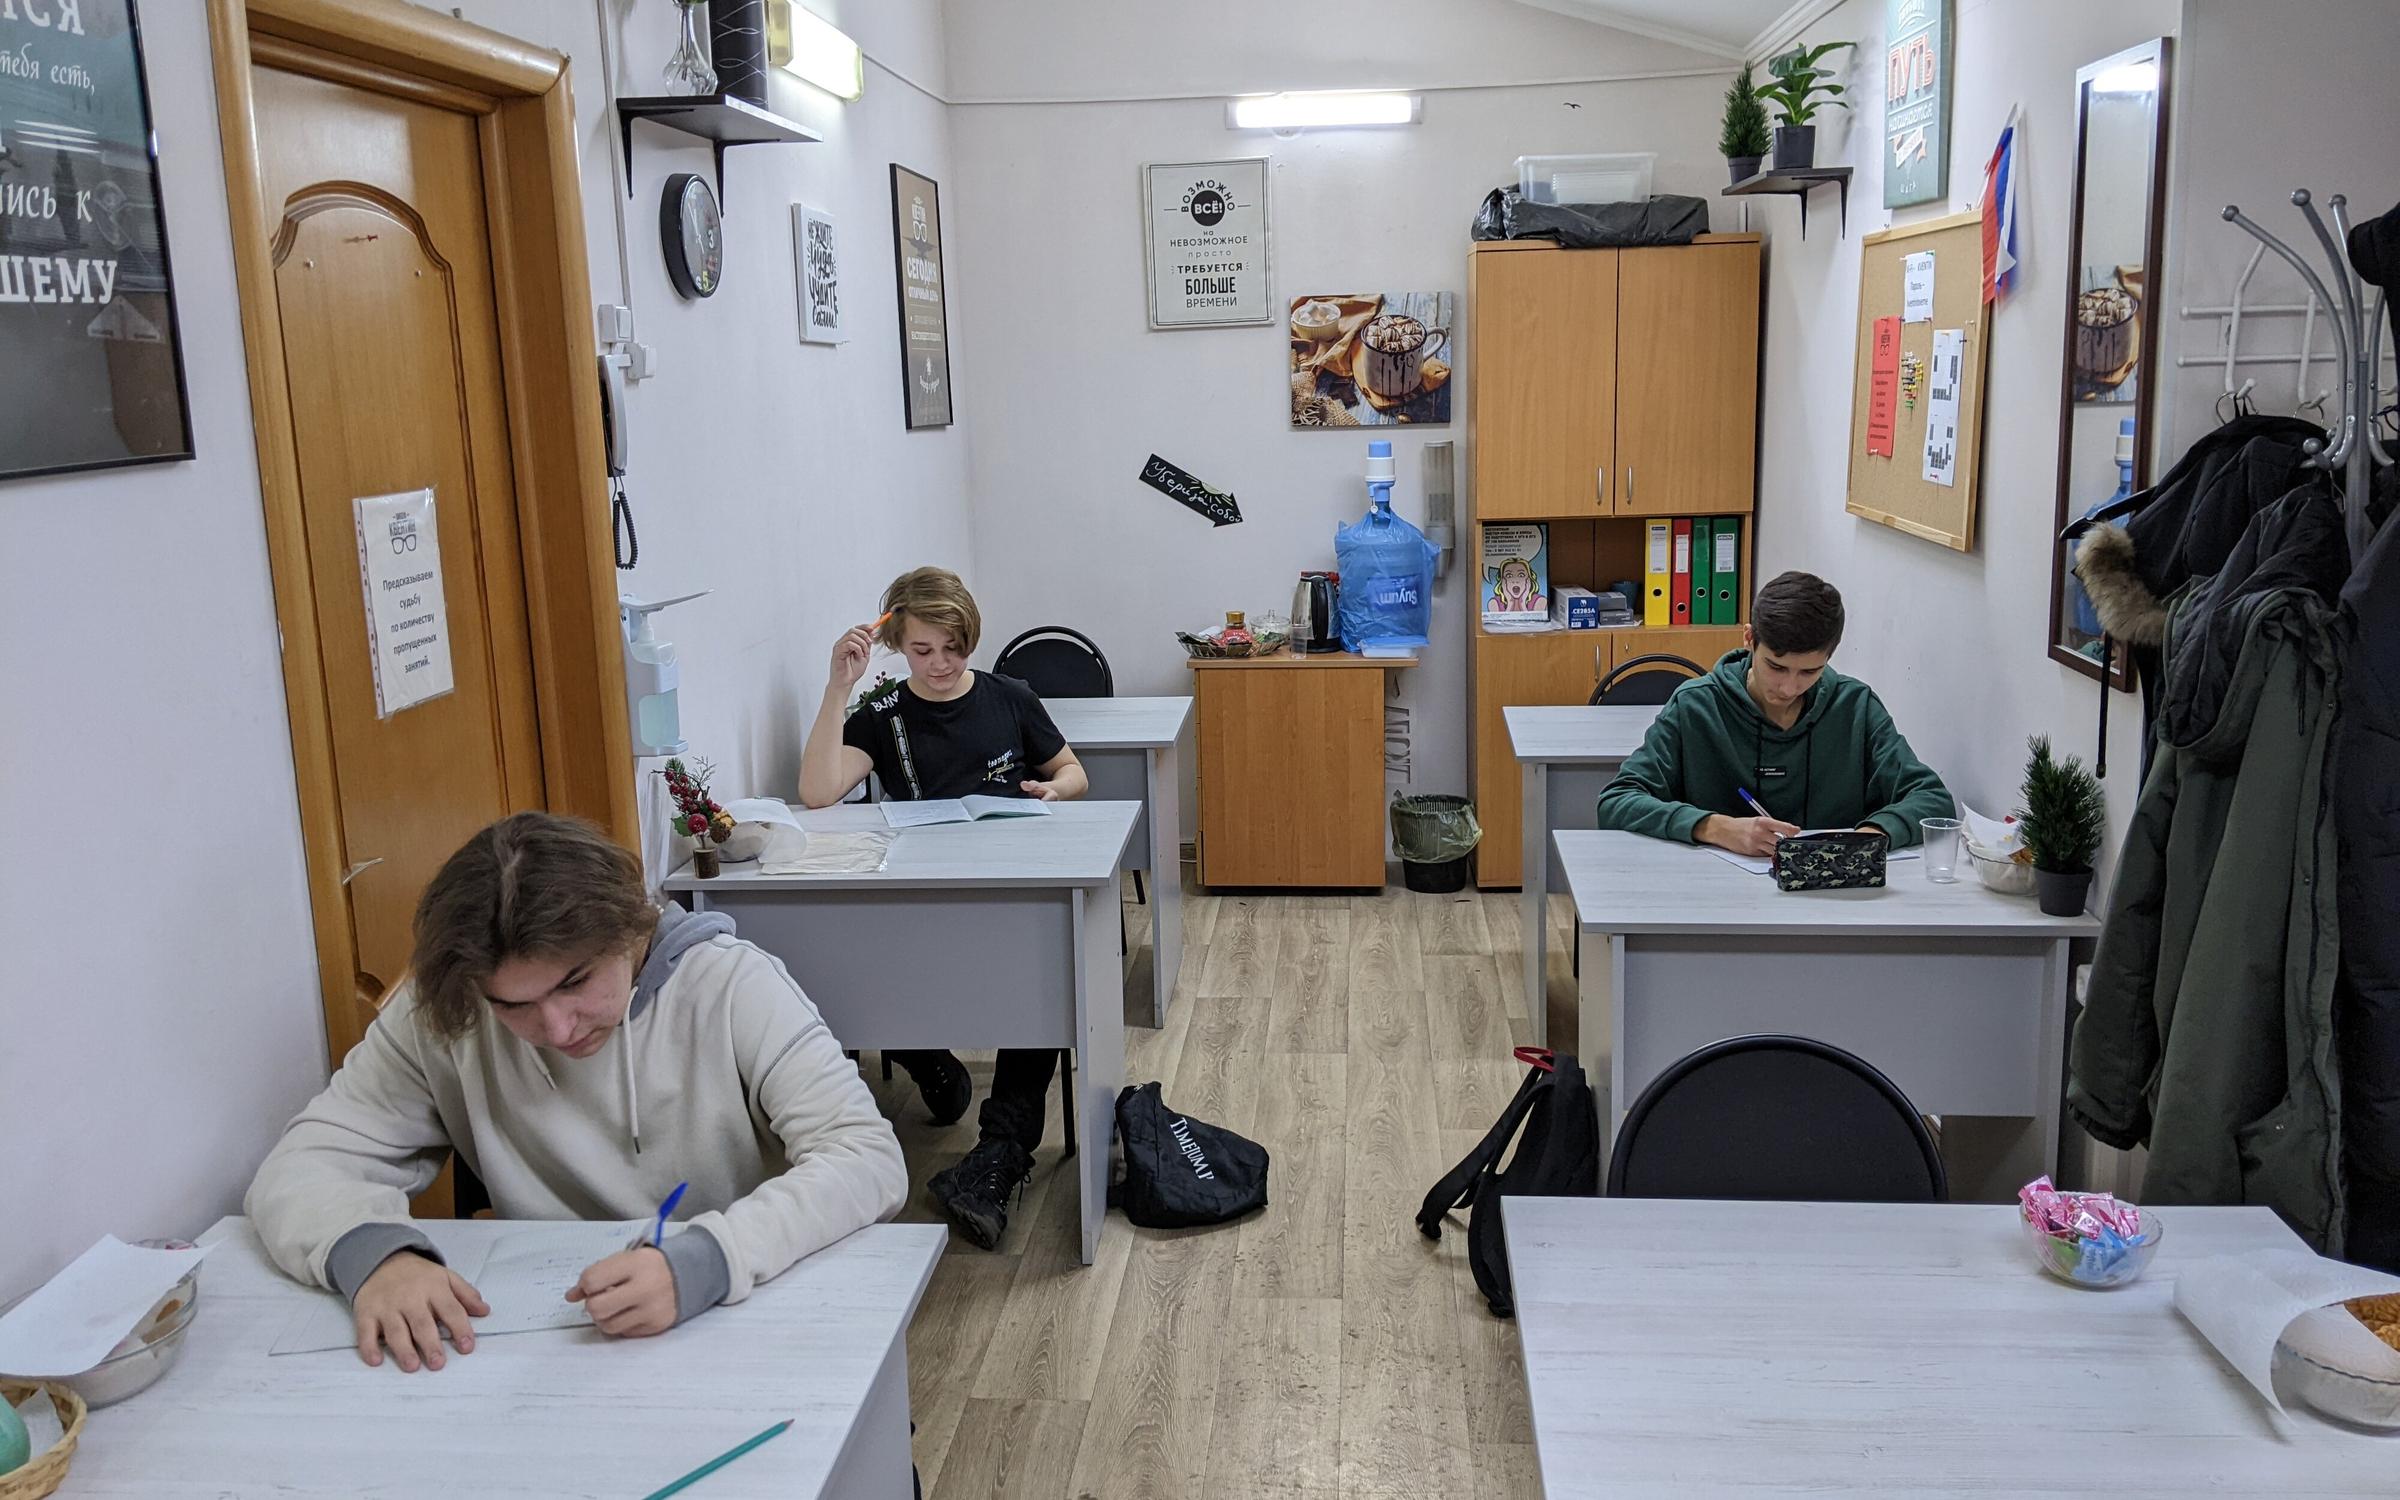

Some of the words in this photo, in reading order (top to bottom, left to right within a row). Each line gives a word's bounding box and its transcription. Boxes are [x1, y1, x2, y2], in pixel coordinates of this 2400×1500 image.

[1888, 32, 1936, 103] ПУТЬ
[50, 64, 95, 96] есть,
[1181, 179, 1235, 213] ВОЗМОЖНО
[1194, 200, 1223, 214] ВСЁ!
[708, 229, 715, 250] 3
[1170, 236, 1248, 247] НЕВОЗМОЖНОЕ
[1188, 249, 1232, 259] просто
[906, 256, 938, 285] СЕГОДНЯ
[1177, 263, 1243, 274] ТРЕБУЕТСЯ
[702, 270, 709, 292] 5
[1185, 276, 1236, 295] БОЛЬШЕ
[1186, 297, 1237, 308] ВРЕМЕНИ
[382, 570, 434, 592] Предсказываем
[399, 592, 421, 611] судьбу
[391, 623, 399, 633] по
[400, 612, 434, 632] количеству
[393, 633, 437, 656] пропущенных
[404, 655, 430, 674] занятий.
[1170, 1117, 1215, 1180] TIMEJUMP
